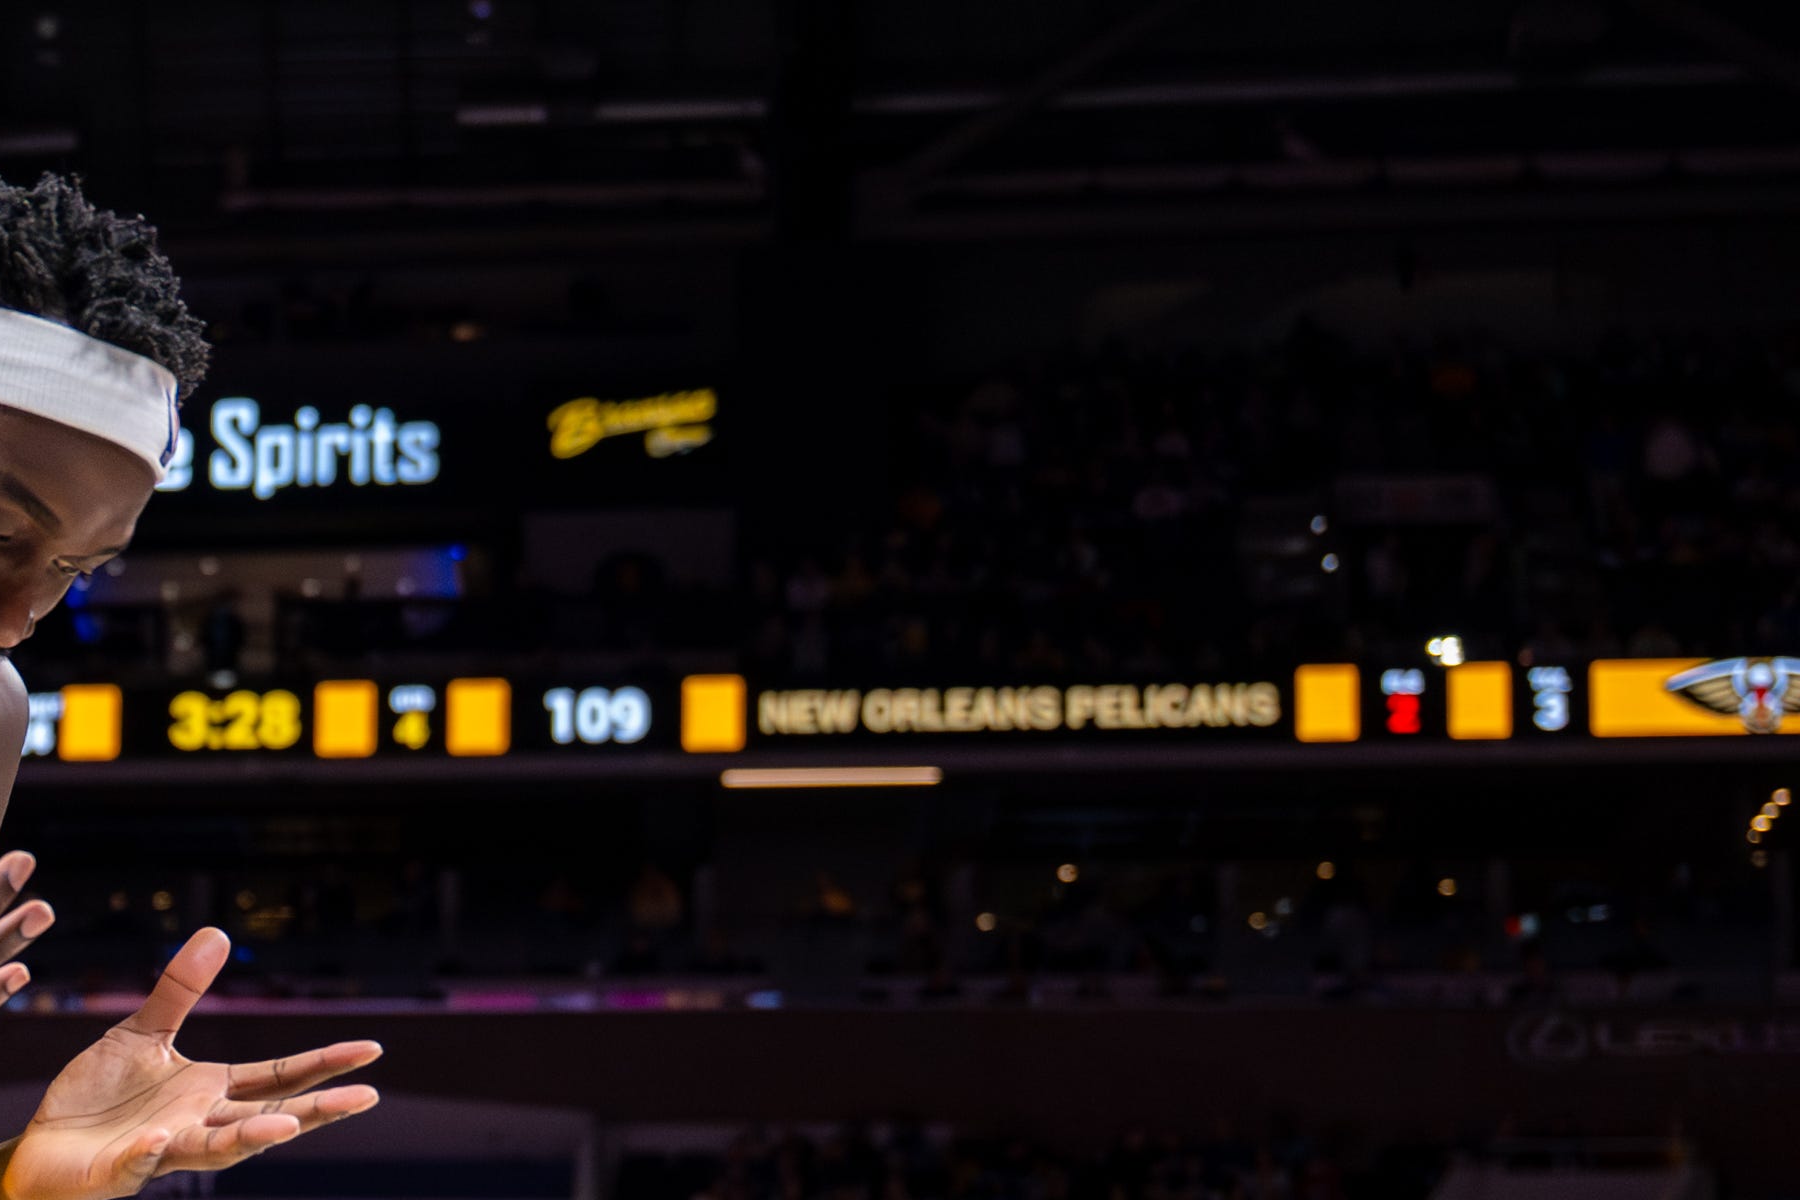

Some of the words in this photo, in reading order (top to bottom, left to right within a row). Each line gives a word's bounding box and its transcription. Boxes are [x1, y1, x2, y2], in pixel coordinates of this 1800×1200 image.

[210, 397, 440, 499] Spirits
[168, 689, 302, 751] 3:28
[393, 711, 431, 750] 4
[543, 686, 652, 744] 109
[758, 689, 861, 735] NEW
[862, 686, 1063, 733] ORLEANS
[1065, 682, 1281, 730] PELICANS
[1532, 689, 1570, 732] 3
